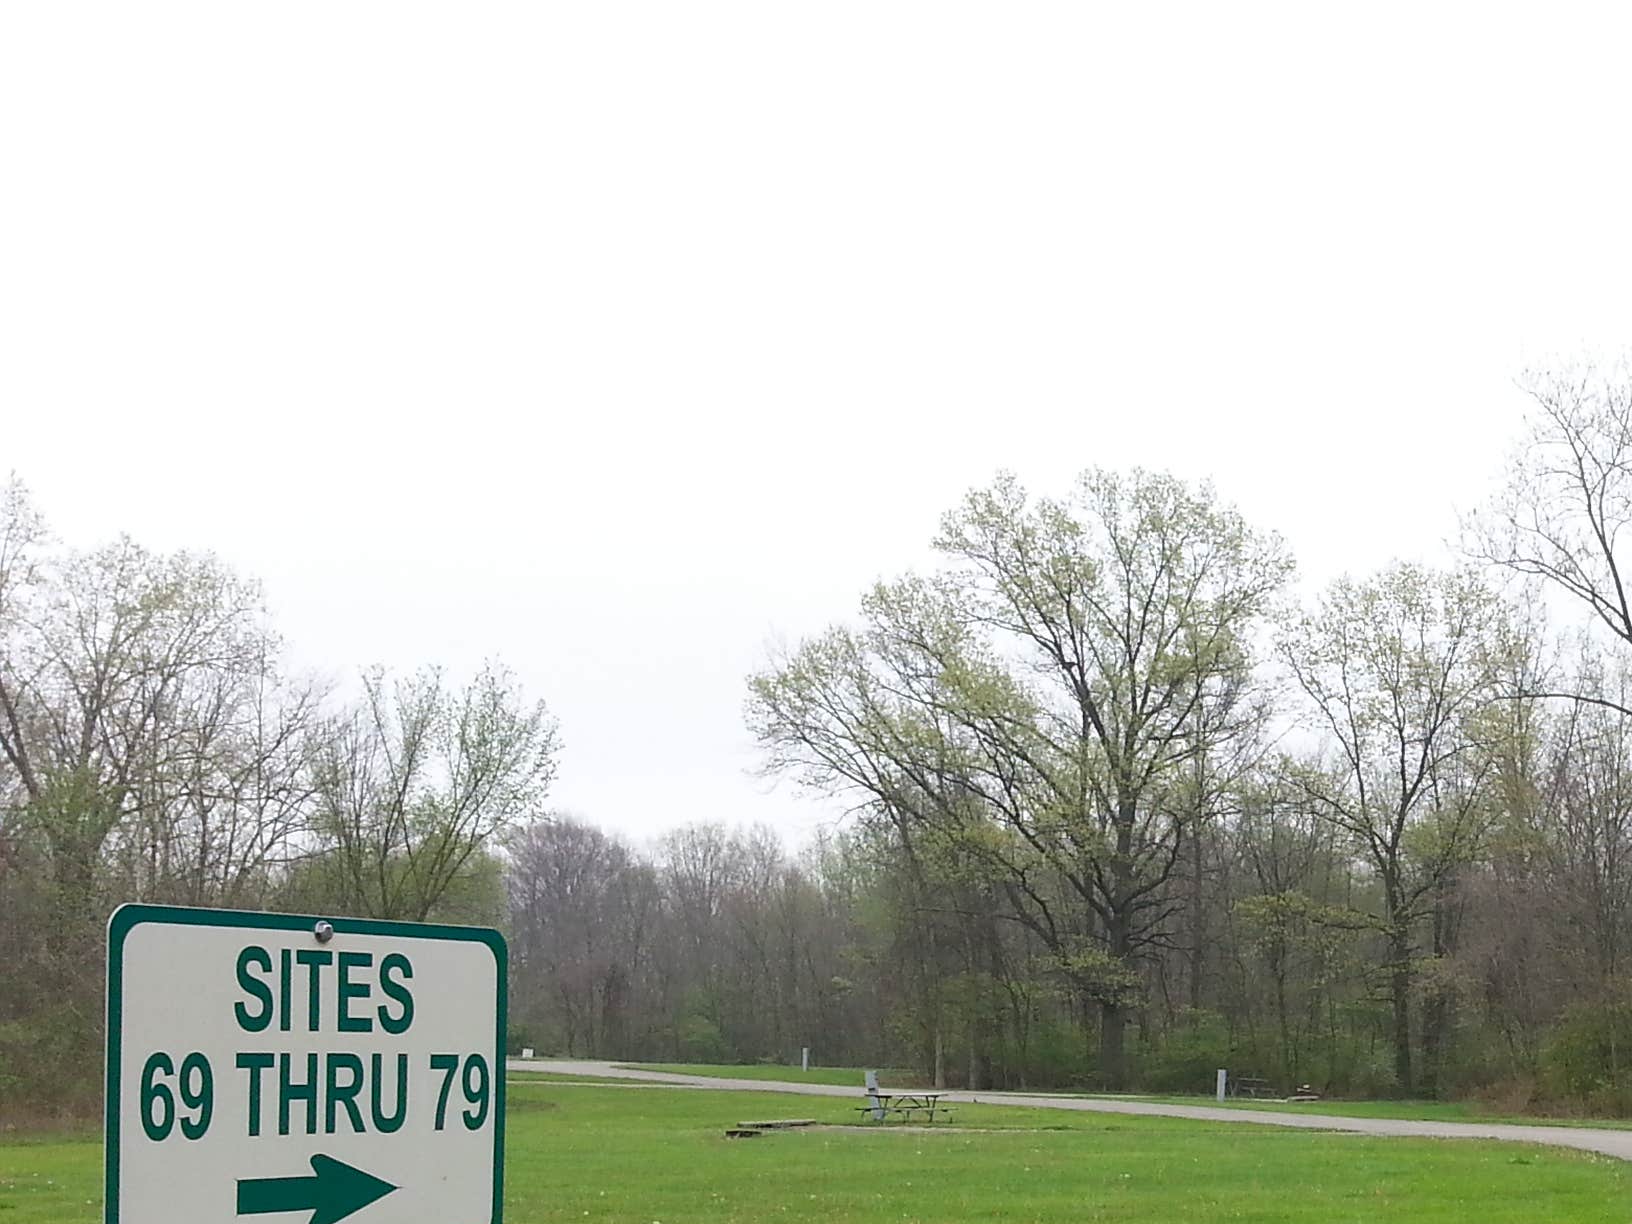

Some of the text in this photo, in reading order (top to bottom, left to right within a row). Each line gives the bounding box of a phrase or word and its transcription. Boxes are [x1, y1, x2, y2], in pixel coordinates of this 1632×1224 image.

[233, 945, 415, 1034] SITES
[139, 1051, 490, 1141] 69 THRU 79
